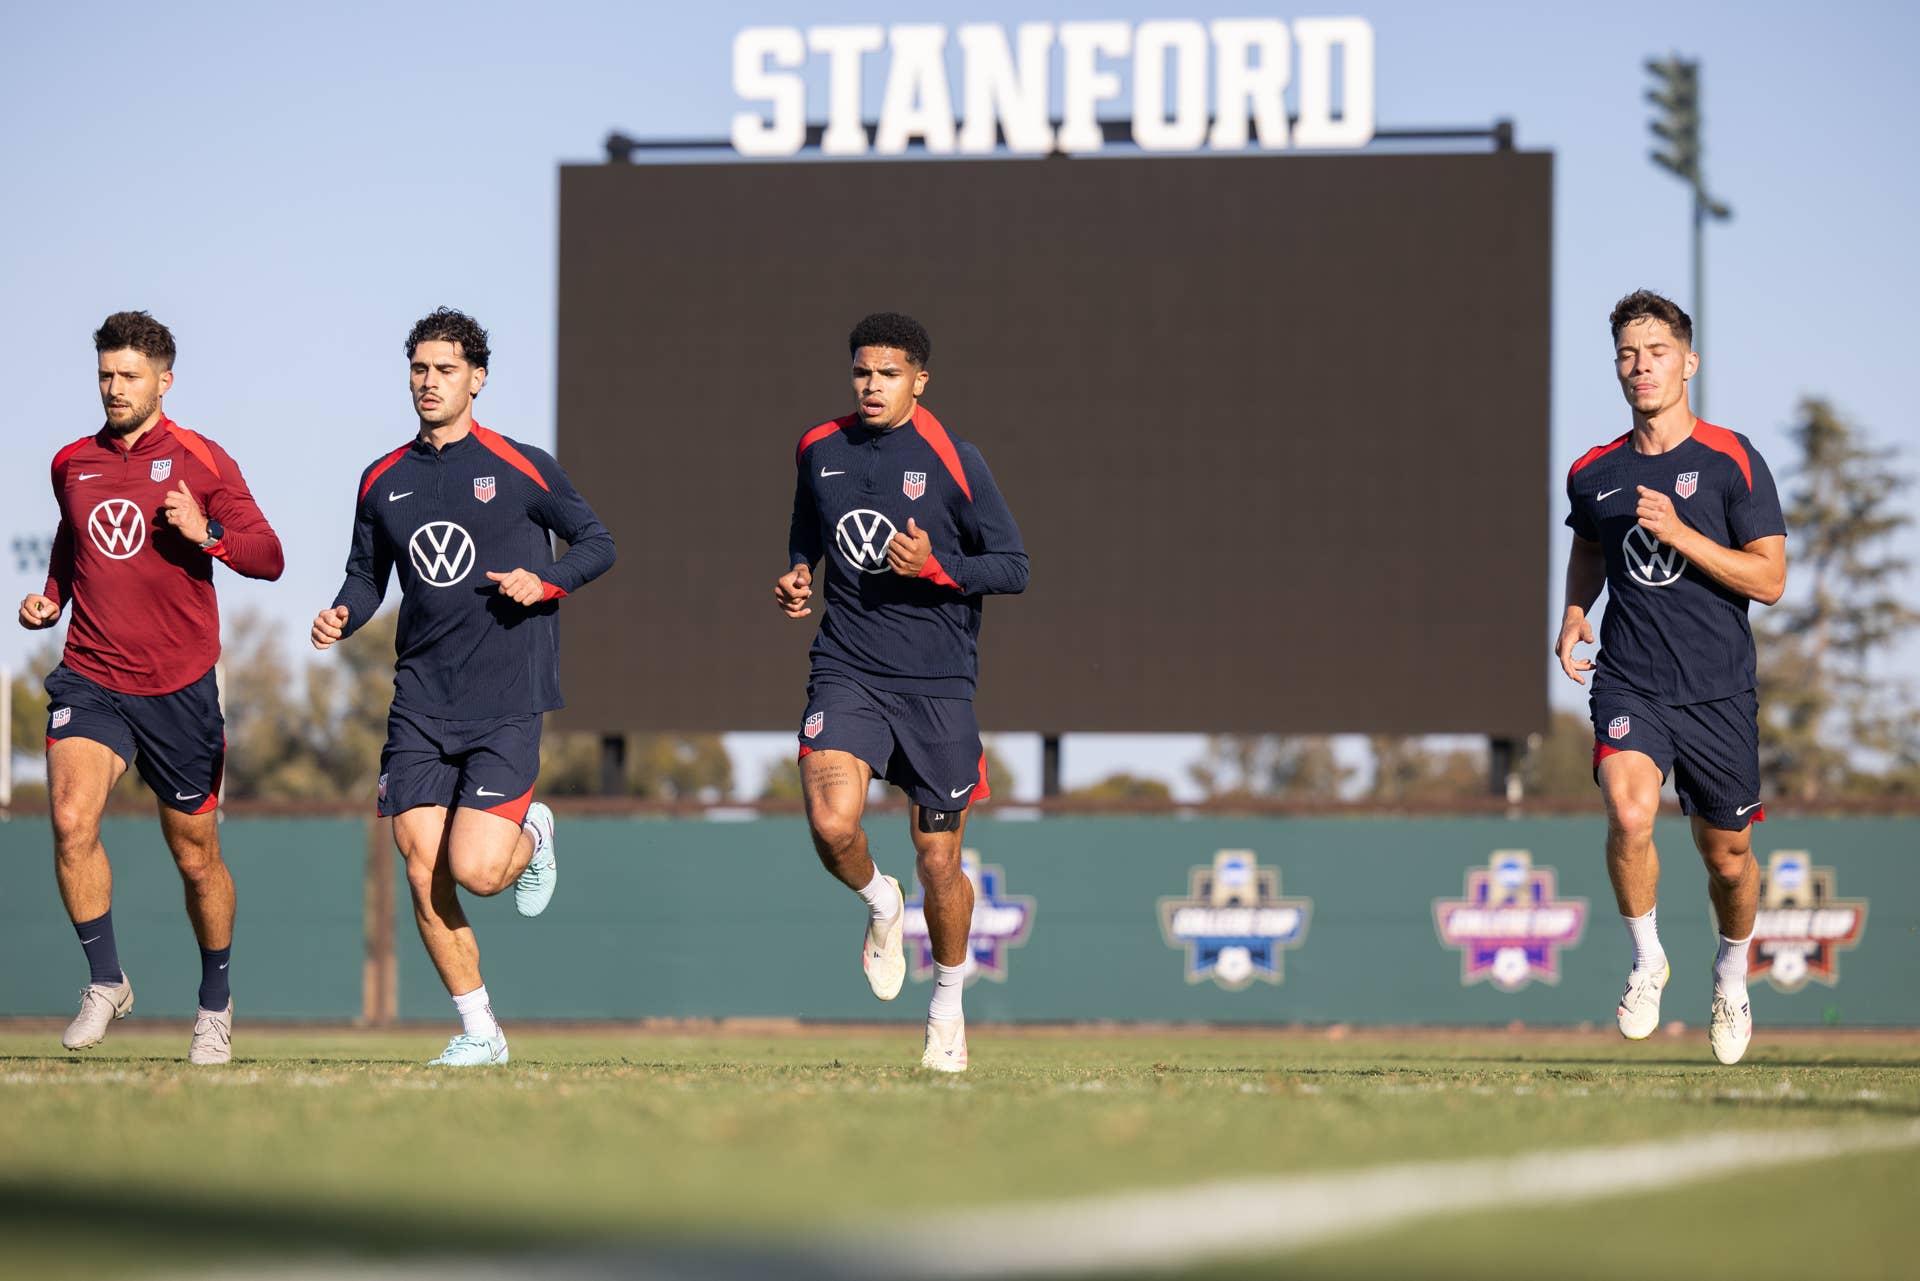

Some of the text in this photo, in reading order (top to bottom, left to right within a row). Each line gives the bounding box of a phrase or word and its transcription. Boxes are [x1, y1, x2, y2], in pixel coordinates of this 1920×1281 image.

[731, 17, 1374, 156] STANFORD
[153, 460, 171, 470] USA
[475, 478, 494, 488] USA
[905, 473, 925, 485] USA
[1678, 473, 1696, 483] USA
[91, 500, 142, 554] VW
[838, 511, 897, 568] VW
[411, 523, 472, 583] VW
[54, 709, 70, 719] USA
[807, 713, 822, 725] USA
[1610, 717, 1628, 728] USA
